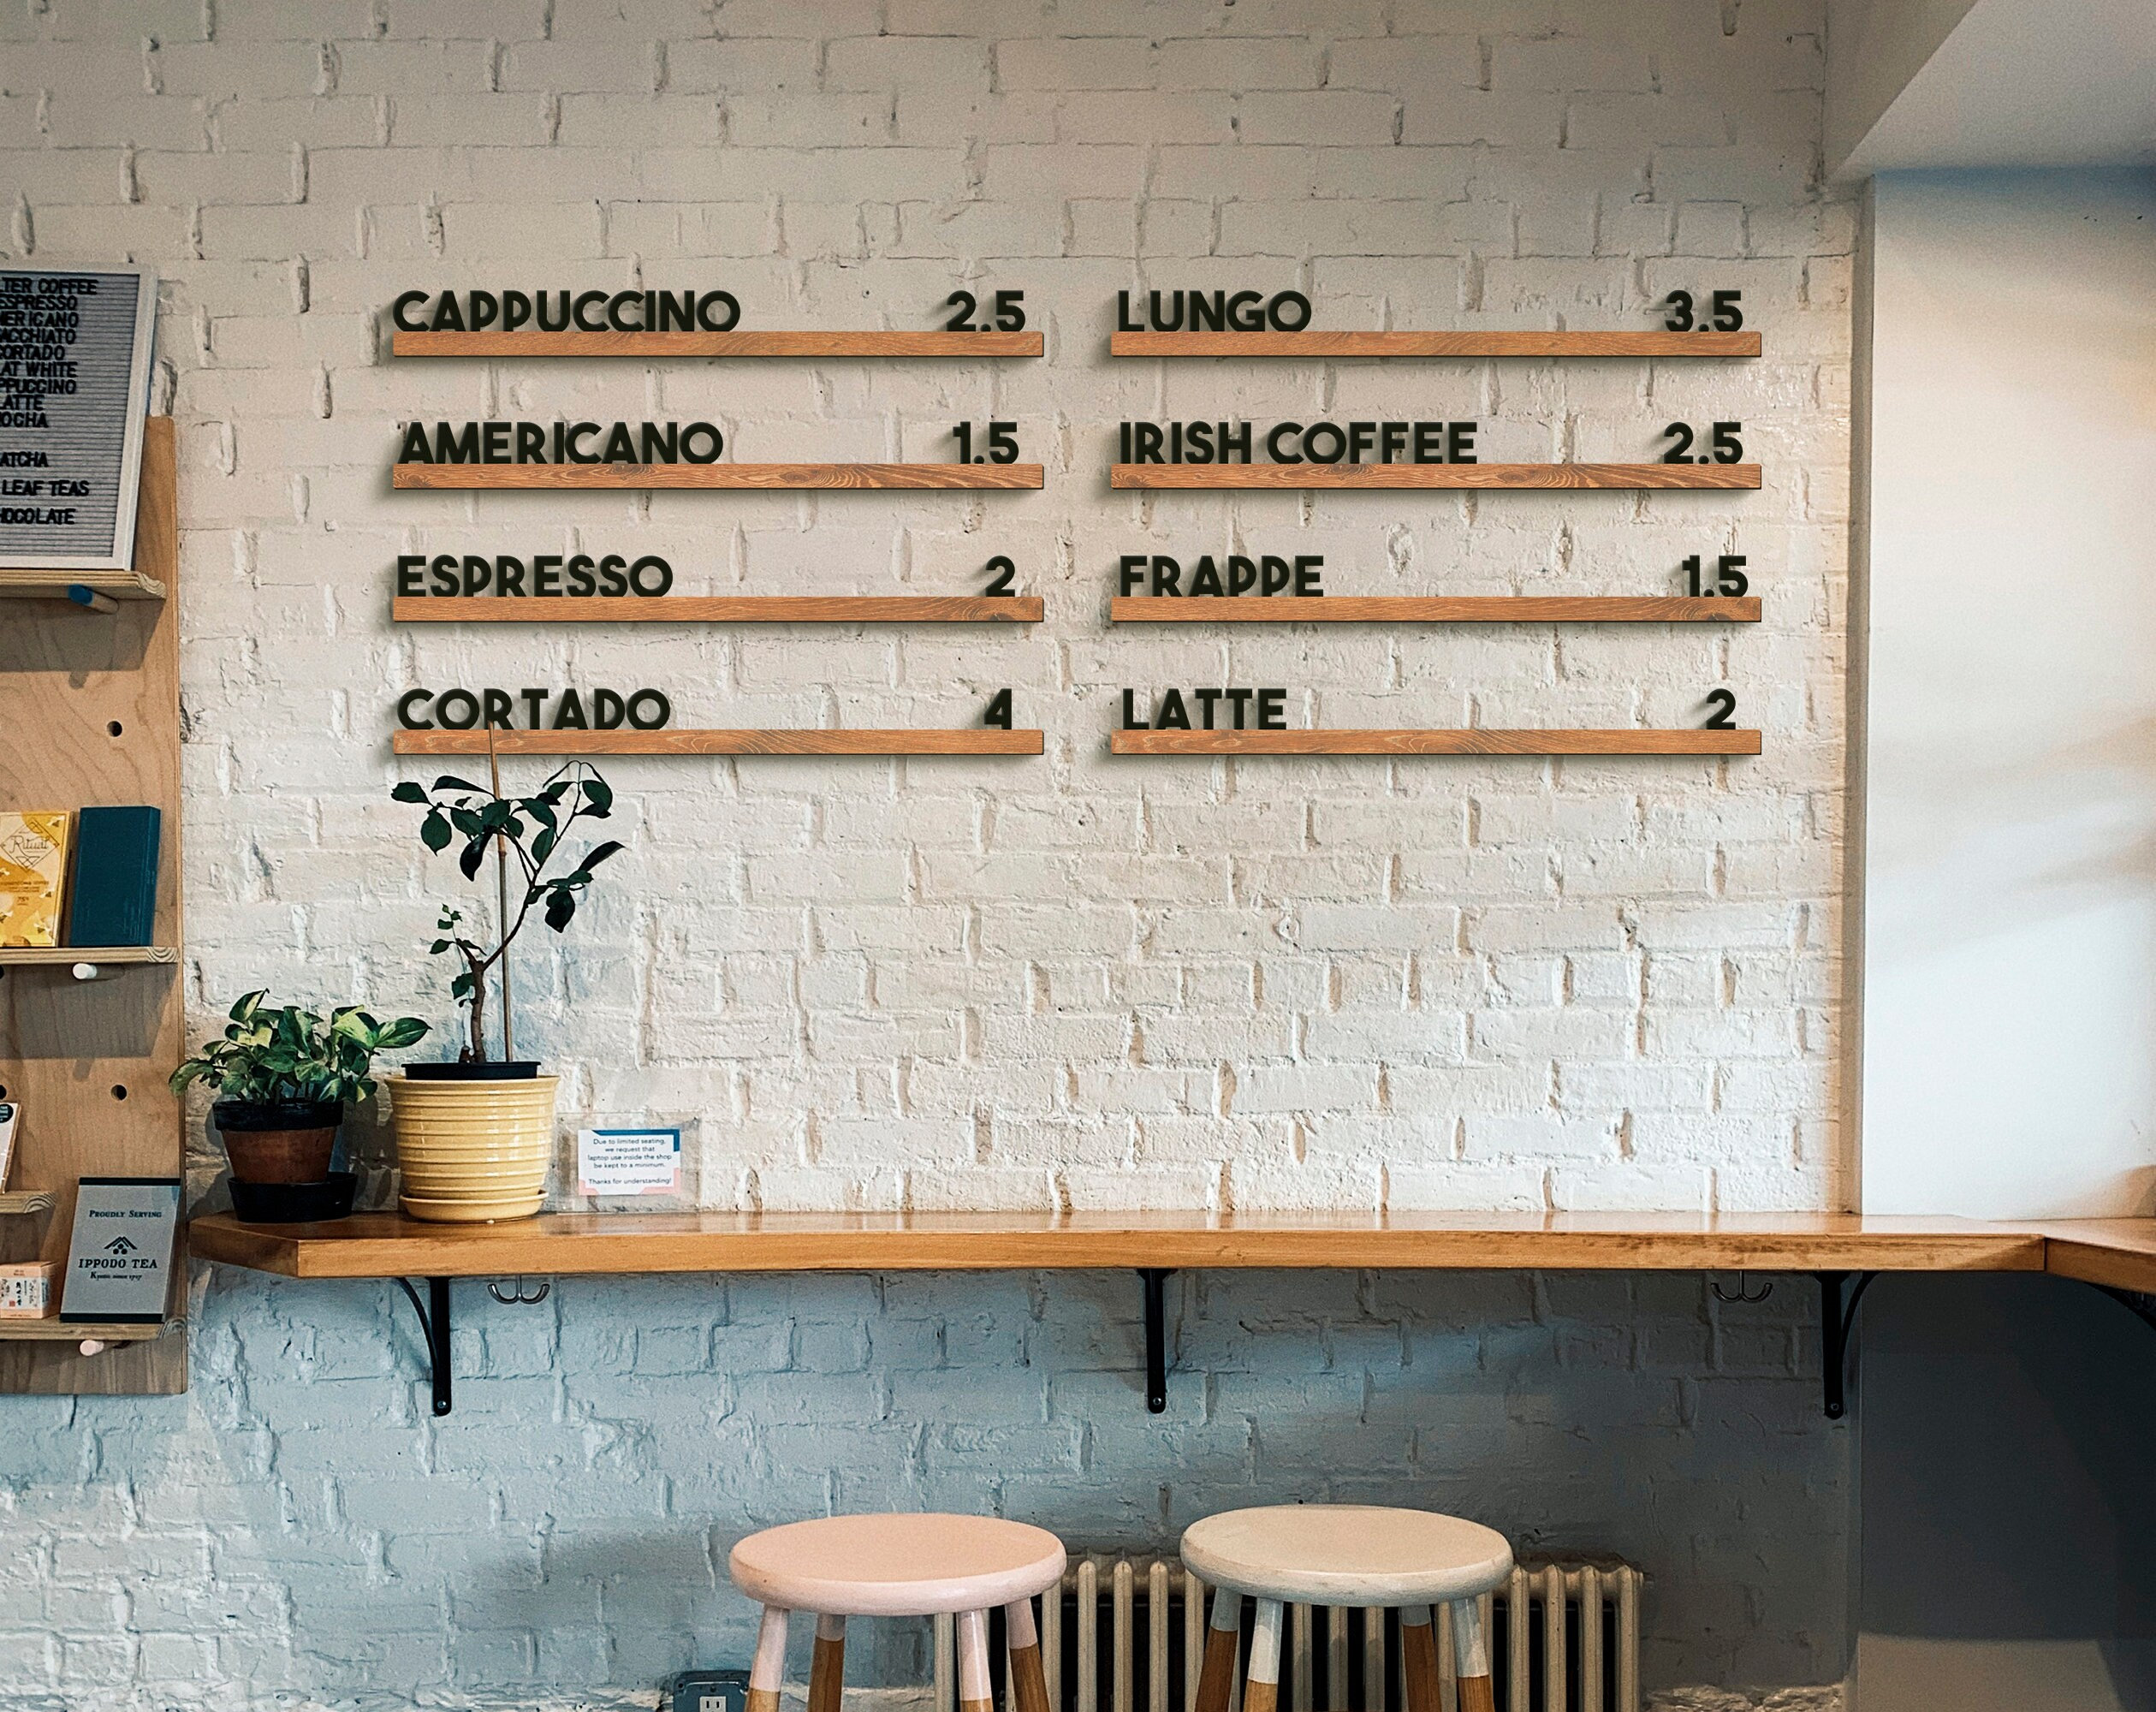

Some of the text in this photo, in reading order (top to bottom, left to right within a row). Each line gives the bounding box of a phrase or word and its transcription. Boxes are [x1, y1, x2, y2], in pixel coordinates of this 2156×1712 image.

[39, 278, 99, 295] COFFEE
[392, 290, 1026, 332] CAPPUCCINO 2.5
[1118, 289, 1743, 332] LUNGO 3.5
[0, 327, 76, 344] ACCHIATO
[26, 361, 78, 377] WHITE
[0, 411, 49, 428] OCHA
[397, 421, 1019, 465] AMERICANO 1.5
[1120, 420, 1743, 465] IRISH COFFEE 2.5
[2, 479, 90, 496] LEAF TEAS
[397, 555, 1016, 597] ESPRESSO 2
[1120, 555, 1749, 597] FRAPPE 1.5
[397, 688, 1013, 730] CORTADO 4
[1122, 688, 1736, 730] LATTE 2
[78, 1258, 157, 1269] IPPODO TEA
